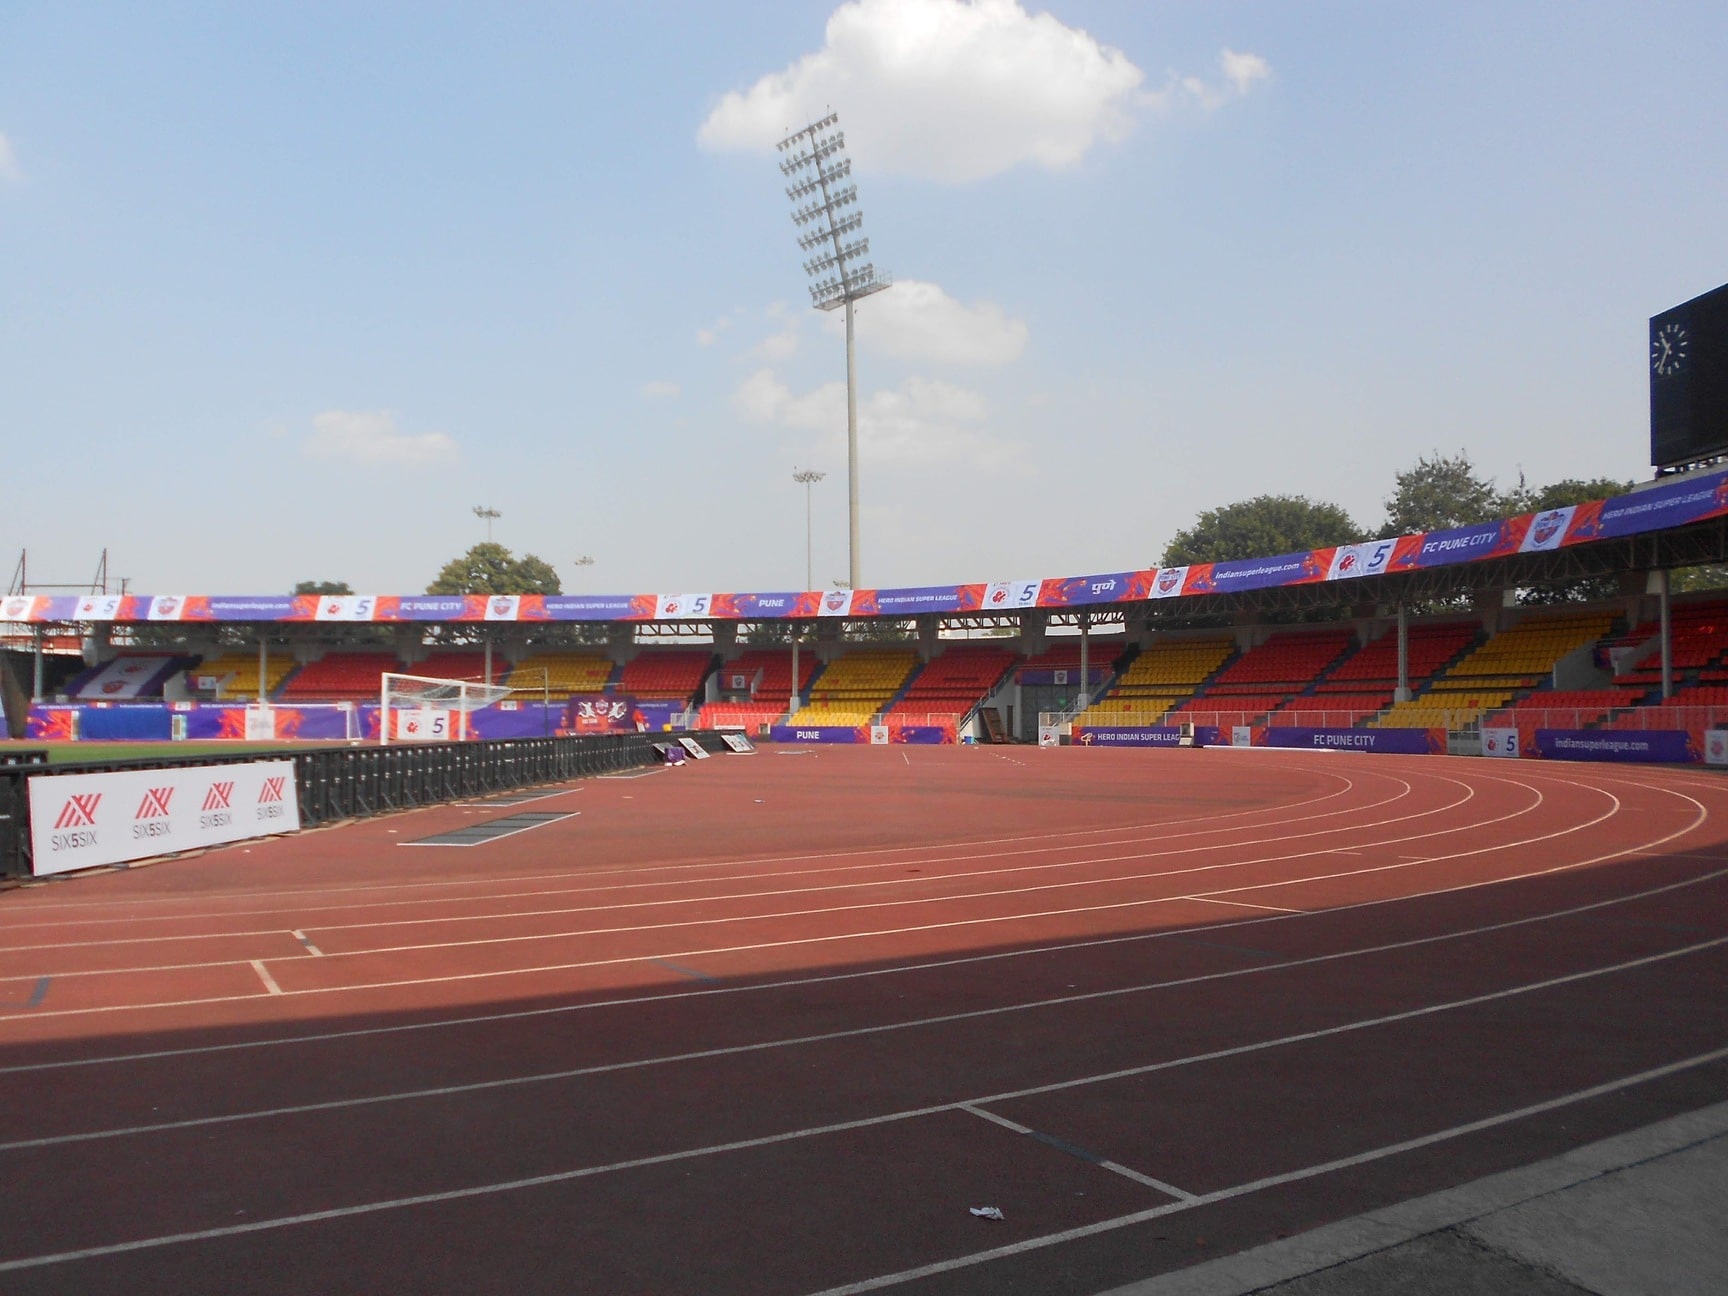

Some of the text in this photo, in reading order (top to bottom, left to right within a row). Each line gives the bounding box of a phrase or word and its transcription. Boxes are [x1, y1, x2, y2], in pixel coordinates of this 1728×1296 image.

[1422, 532, 1497, 553] FC PUNE CITY
[1368, 544, 1391, 568] 5
[1019, 584, 1037, 602] 5
[355, 600, 371, 615] 5
[400, 602, 462, 610] FC PUNE CITY
[692, 597, 707, 613] 5
[758, 599, 785, 608] PUNE
[432, 717, 444, 734] 5
[796, 731, 820, 740] PUNE
[1097, 733, 1116, 741] HERO
[1116, 733, 1140, 741] INDIAN
[1140, 733, 1162, 741] SUPER
[1313, 734, 1376, 746] FC PUNE CITY
[1506, 735, 1516, 752] 5
[257, 805, 284, 820] SIX5SIX
[200, 814, 233, 829] SIX5SIX
[133, 822, 172, 840] SIX5SIX
[51, 831, 98, 852] SIX5SIX
